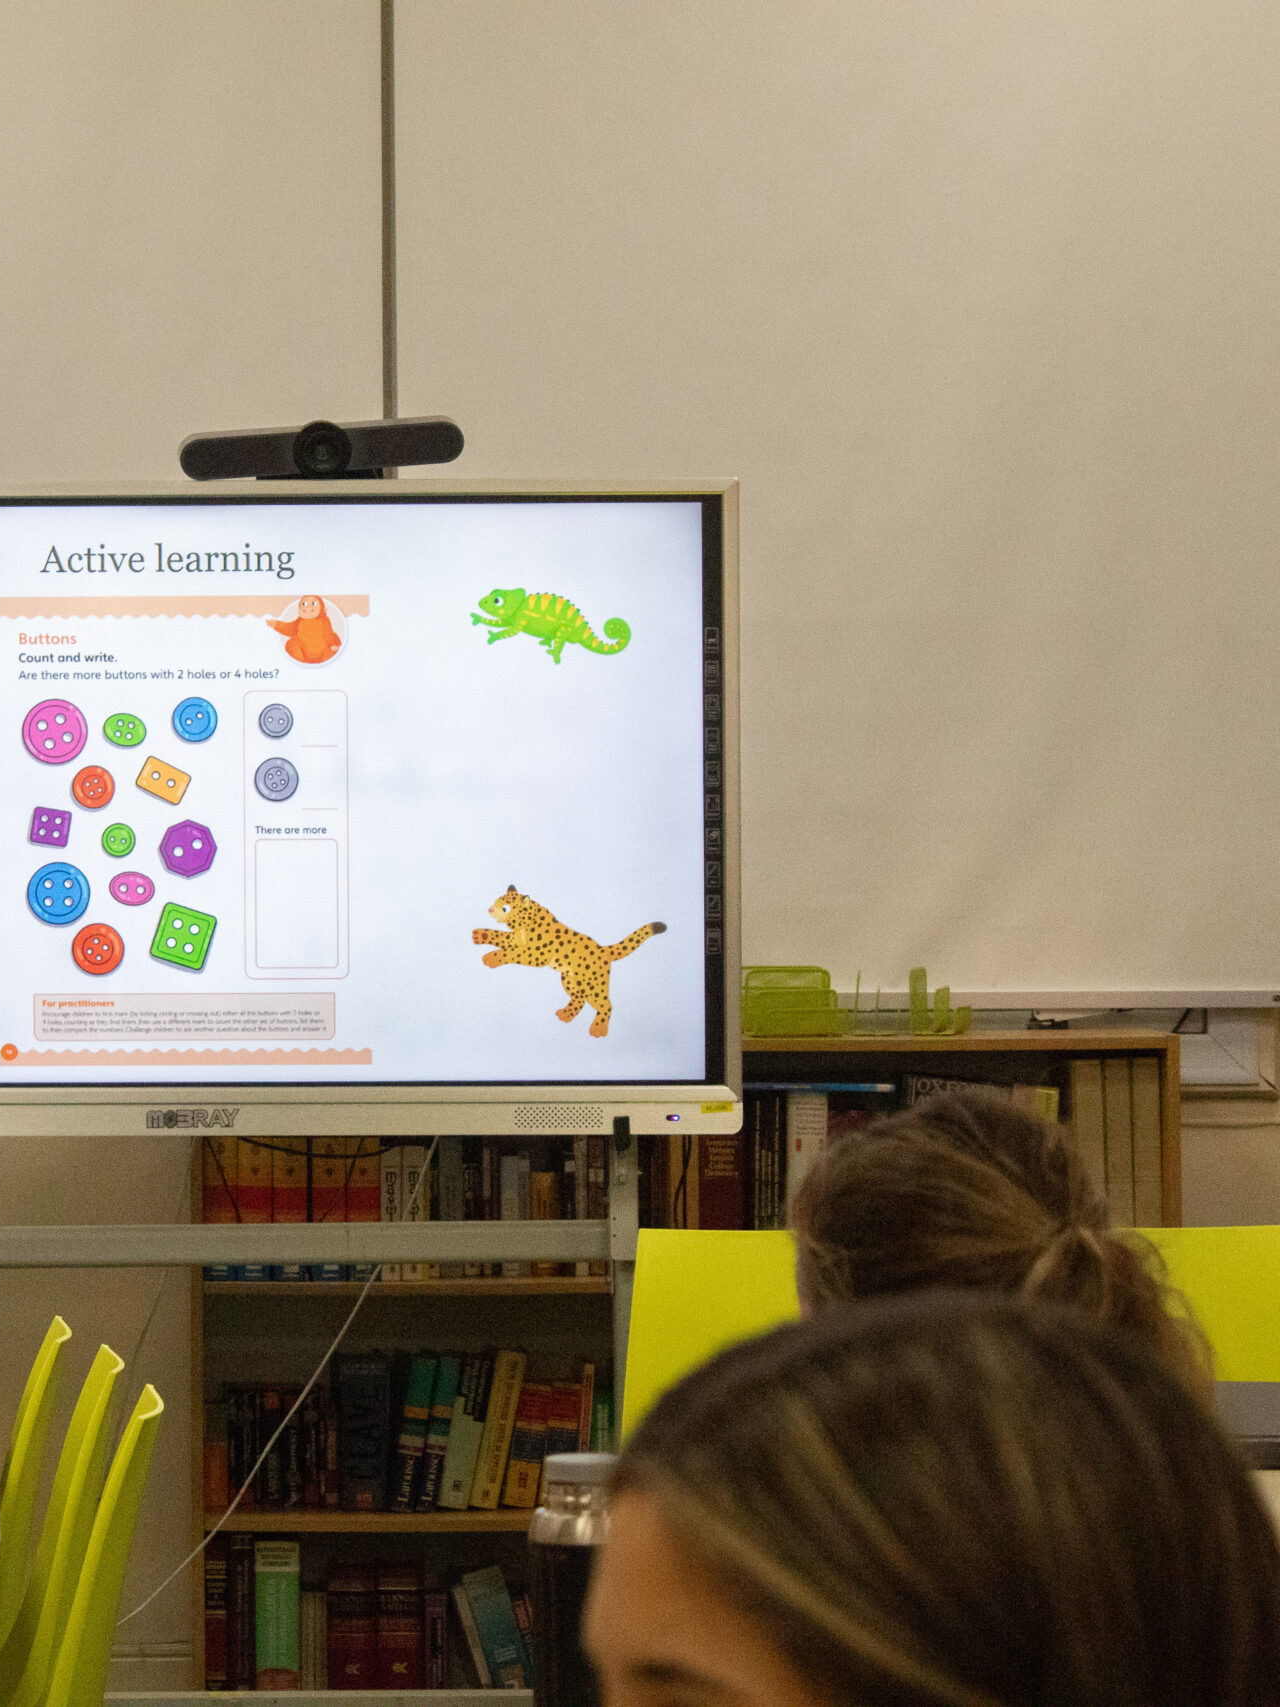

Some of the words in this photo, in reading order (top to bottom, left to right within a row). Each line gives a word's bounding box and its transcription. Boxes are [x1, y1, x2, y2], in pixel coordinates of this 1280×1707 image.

[40, 543, 145, 574] Active
[154, 542, 296, 579] learning
[18, 632, 77, 645] Buttons
[18, 652, 55, 663] Count
[58, 652, 81, 663] and
[84, 652, 118, 663] write.
[18, 670, 38, 681] Are
[40, 670, 70, 681] there
[72, 672, 102, 681] more
[104, 670, 148, 680] buttons
[150, 670, 175, 680] with
[177, 669, 184, 680] 2
[187, 669, 217, 680] holes
[219, 671, 232, 680] or
[234, 669, 242, 679] 4
[244, 669, 280, 680] holes?
[255, 825, 282, 835] There
[284, 827, 300, 835] are
[302, 827, 328, 835] more
[42, 1000, 56, 1008] For
[58, 1000, 115, 1009] practitioners
